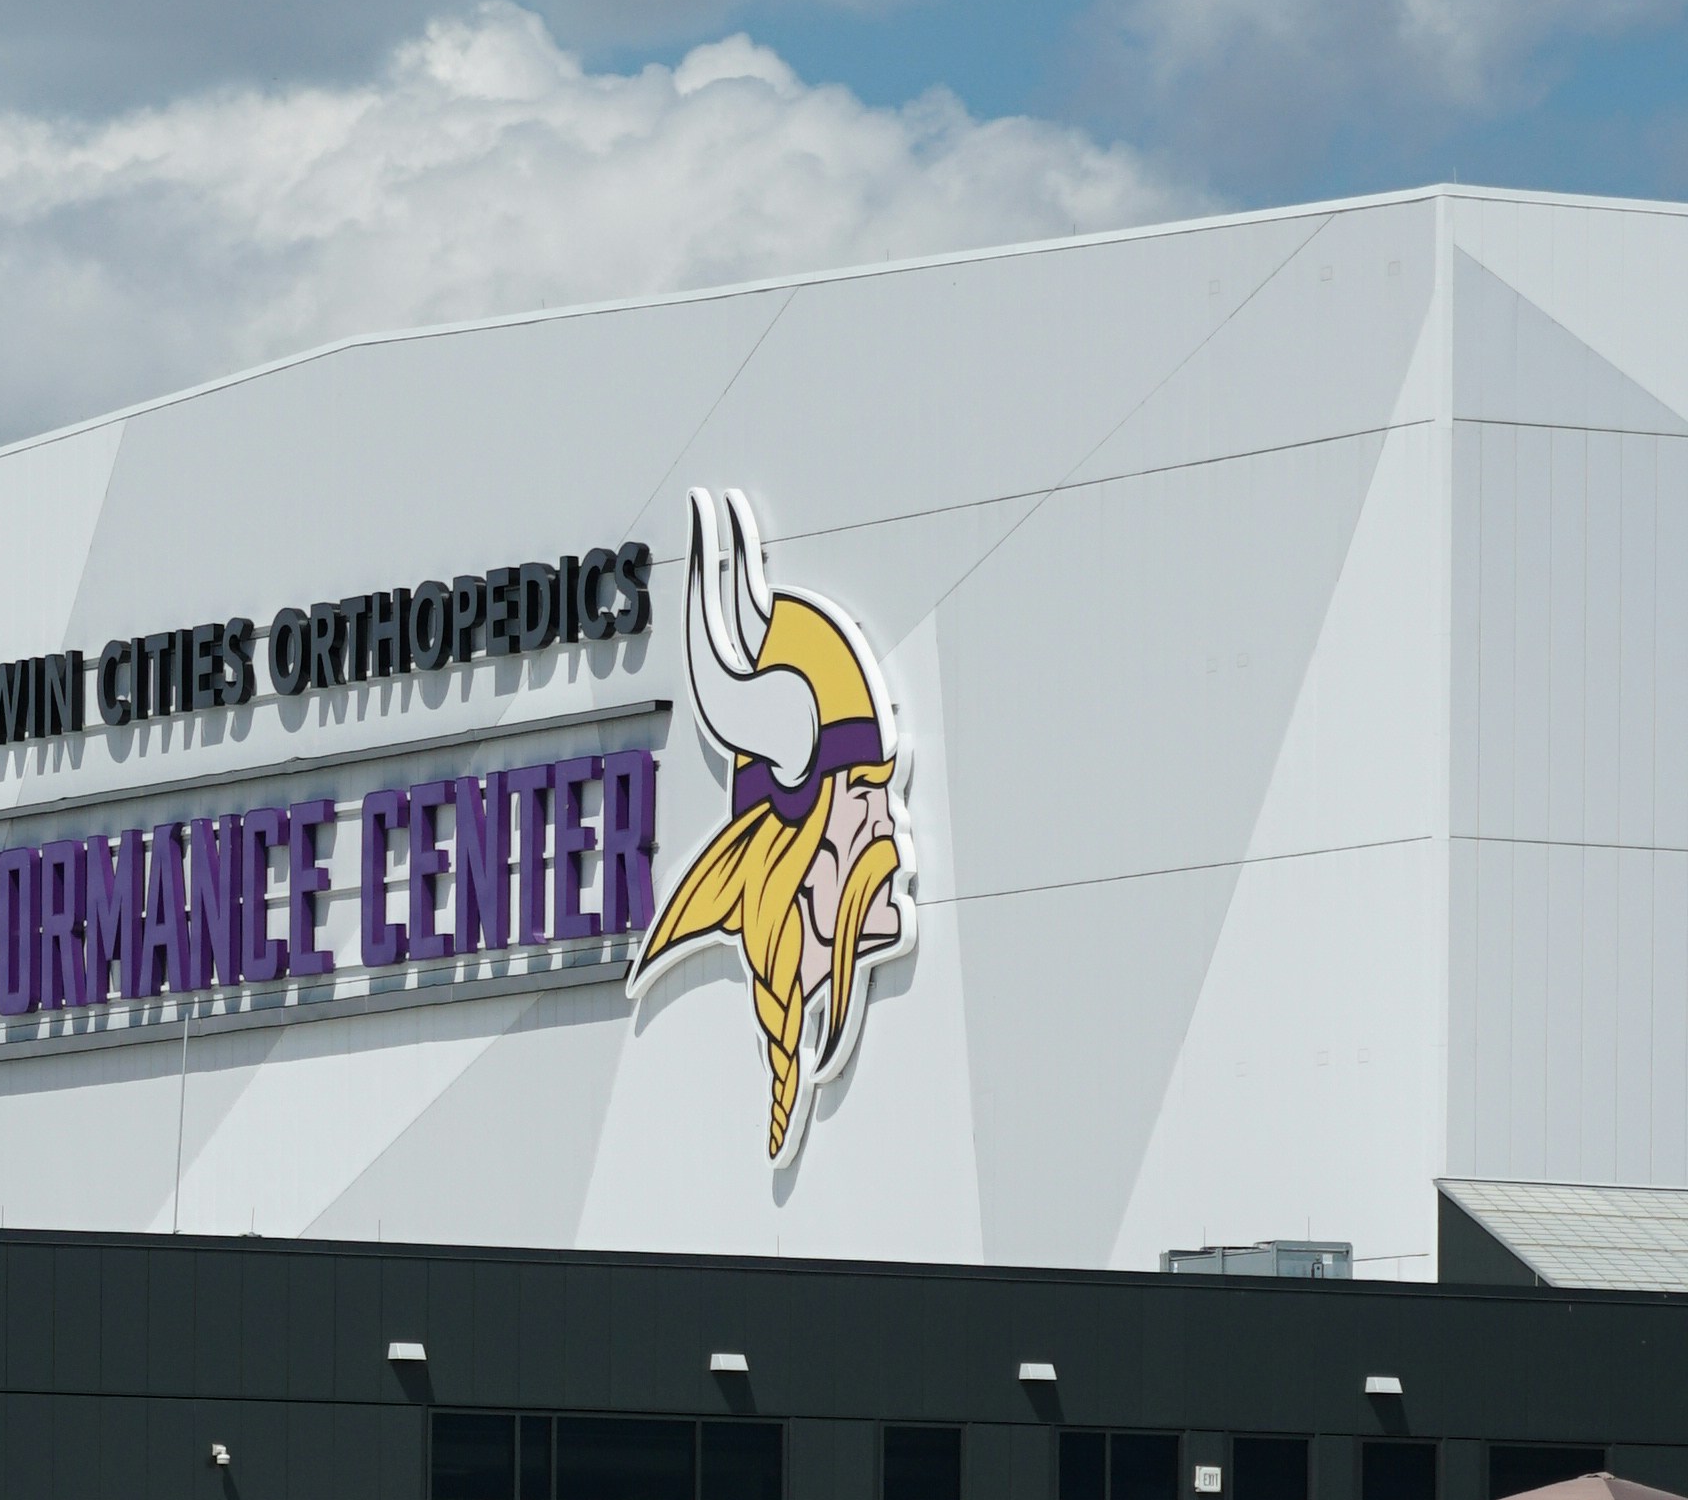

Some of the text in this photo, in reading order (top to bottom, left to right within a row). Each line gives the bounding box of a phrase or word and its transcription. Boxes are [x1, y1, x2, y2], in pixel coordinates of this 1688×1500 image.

[97, 616, 255, 727] CITIES
[268, 542, 652, 696] ORTHOPEDICS
[360, 749, 656, 966] CENTER
[1203, 1473, 1219, 1487] EXIT
